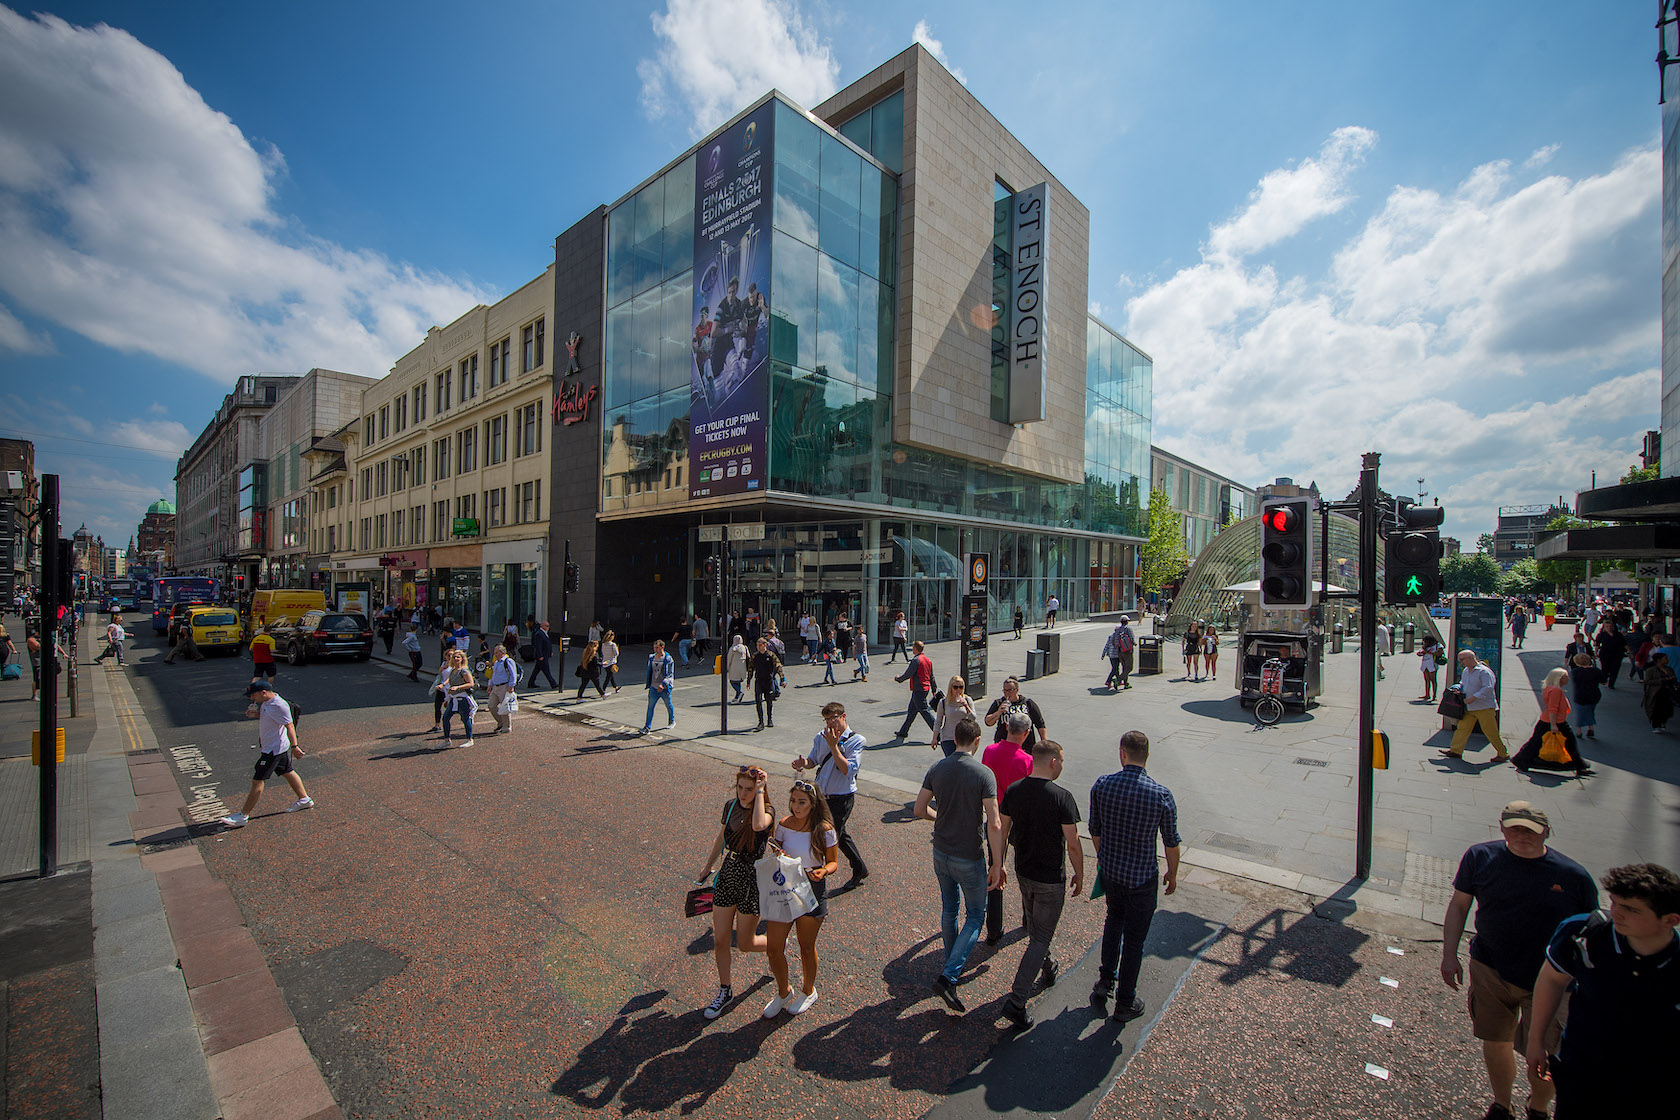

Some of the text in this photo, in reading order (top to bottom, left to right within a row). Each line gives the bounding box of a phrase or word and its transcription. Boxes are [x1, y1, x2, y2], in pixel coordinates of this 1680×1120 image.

[738, 150, 760, 167] CHAMPIONS
[744, 160, 753, 168] CUP
[702, 182, 735, 210] FINALS
[702, 180, 761, 224] EDINBURGH
[702, 198, 761, 236] BT MURRAYFIELD STADIUM
[714, 228, 724, 238] AND
[730, 218, 740, 230] MAY
[740, 212, 752, 224] 2017
[1016, 198, 1041, 365] ST ENOCH
[550, 380, 595, 424] Hamleys
[694, 411, 760, 434] GET YOUR CUP FINAL
[704, 426, 748, 443] TICKETS NOW
[700, 443, 752, 462] EPCRUGBY.COM
[703, 529, 712, 540] ST
